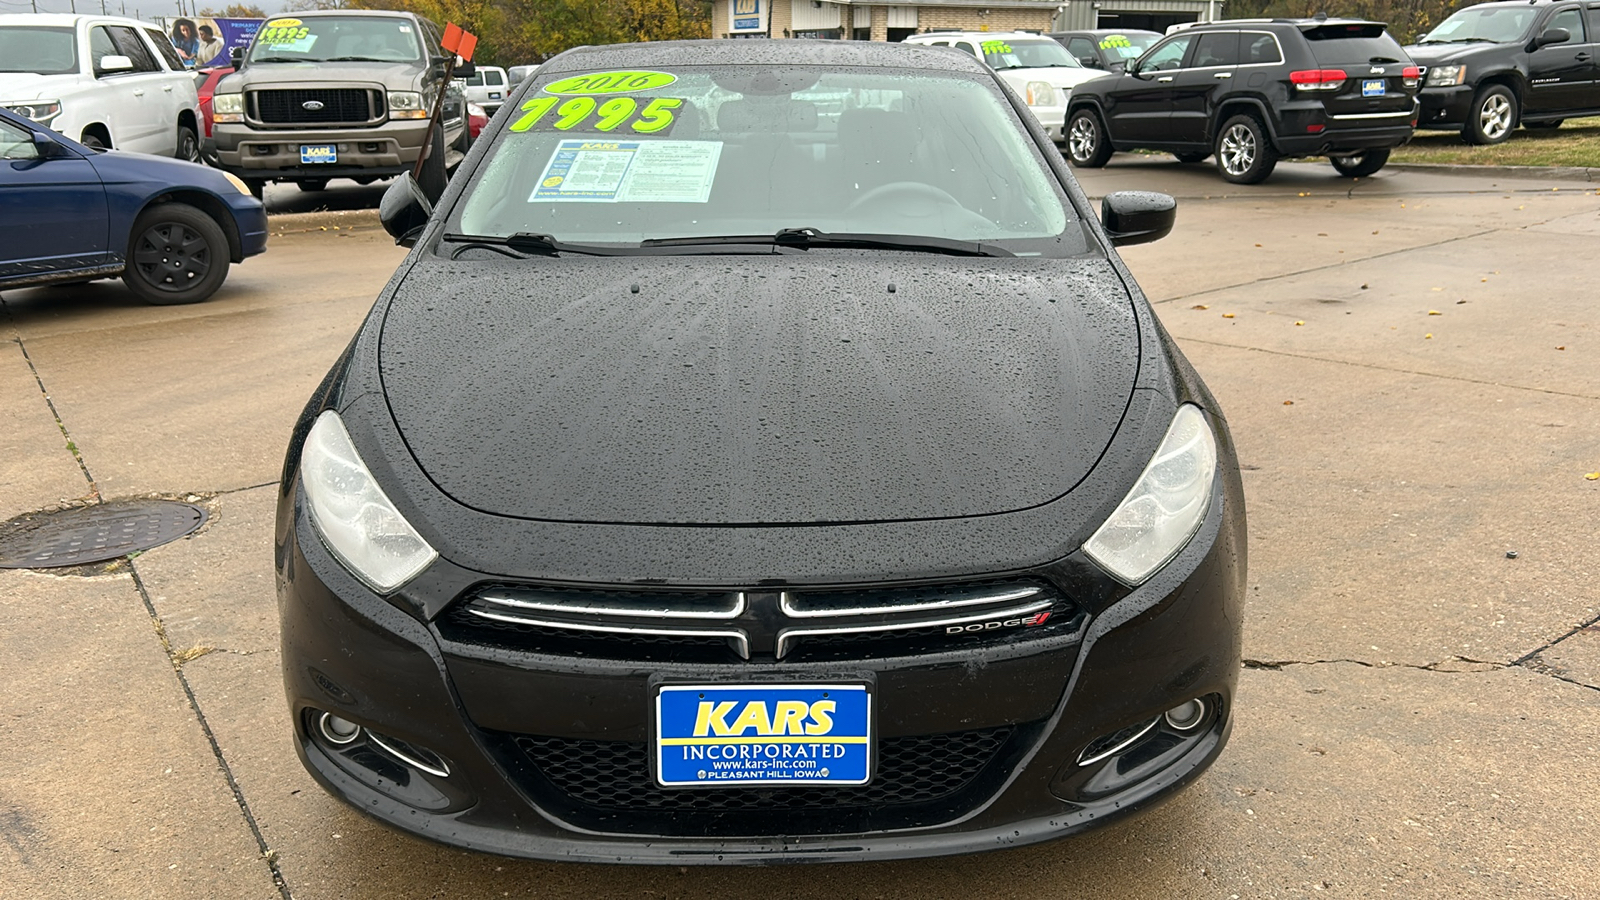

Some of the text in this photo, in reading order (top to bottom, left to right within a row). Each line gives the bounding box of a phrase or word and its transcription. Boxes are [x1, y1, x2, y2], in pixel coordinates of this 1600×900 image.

[562, 73, 657, 92] 2016
[509, 97, 683, 133] 7995
[580, 142, 619, 150] KARS
[946, 617, 1038, 634] DODGE
[692, 700, 837, 737] KARS
[683, 744, 846, 760] INCORPORATED
[713, 758, 817, 770] www.kars-inc.com
[708, 770, 821, 779] PLEASANT HILL, IOWA
